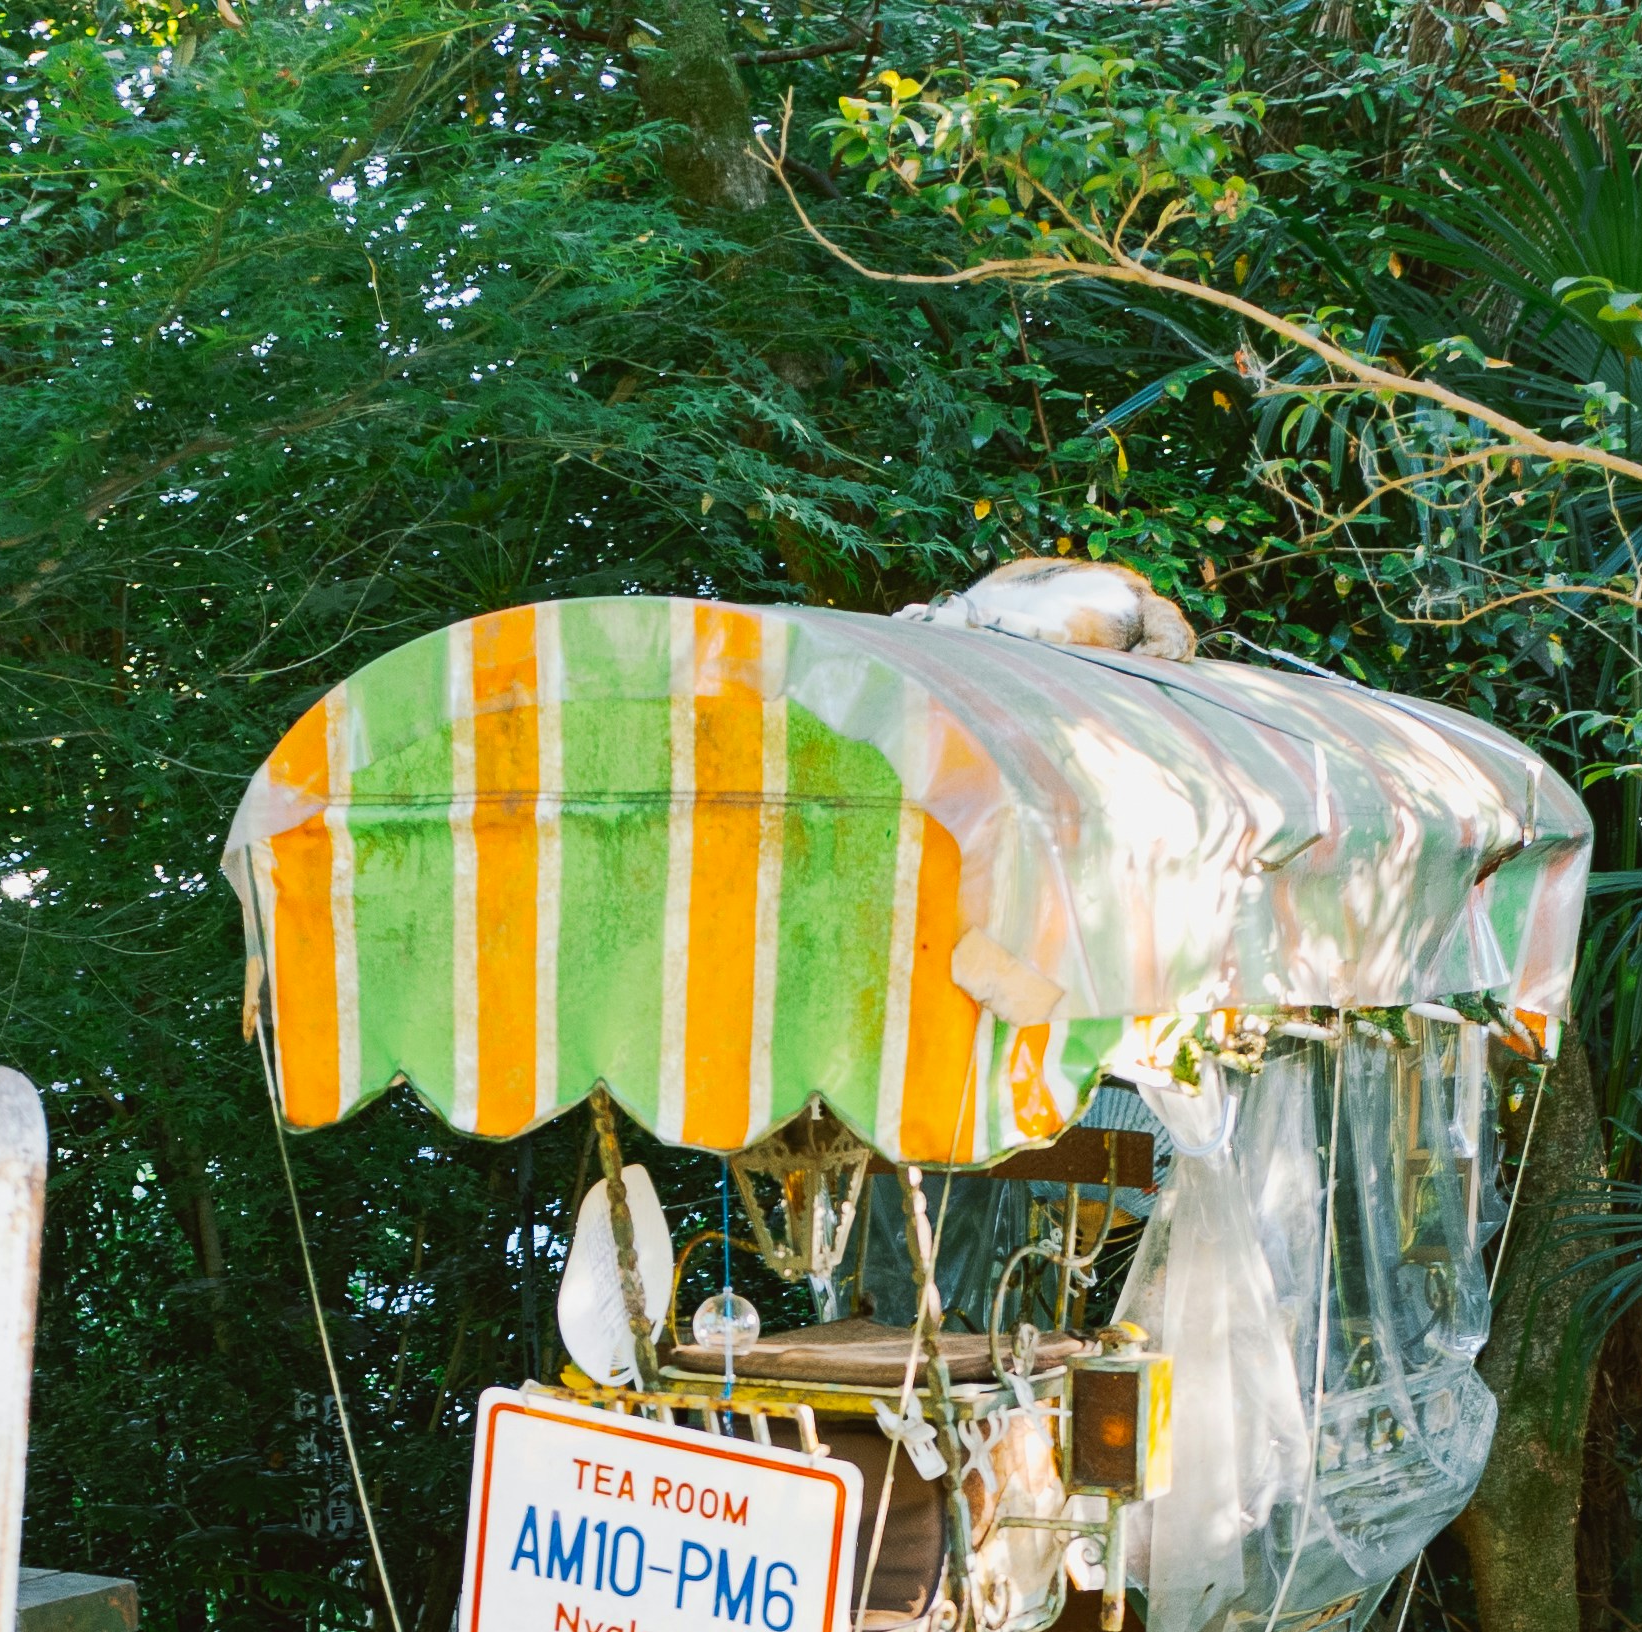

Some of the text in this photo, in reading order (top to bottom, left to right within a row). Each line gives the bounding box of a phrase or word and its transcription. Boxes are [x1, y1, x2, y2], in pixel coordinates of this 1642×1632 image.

[573, 1458, 748, 1526] TEA ROOM
[511, 1505, 797, 1632] AM10-PM6
